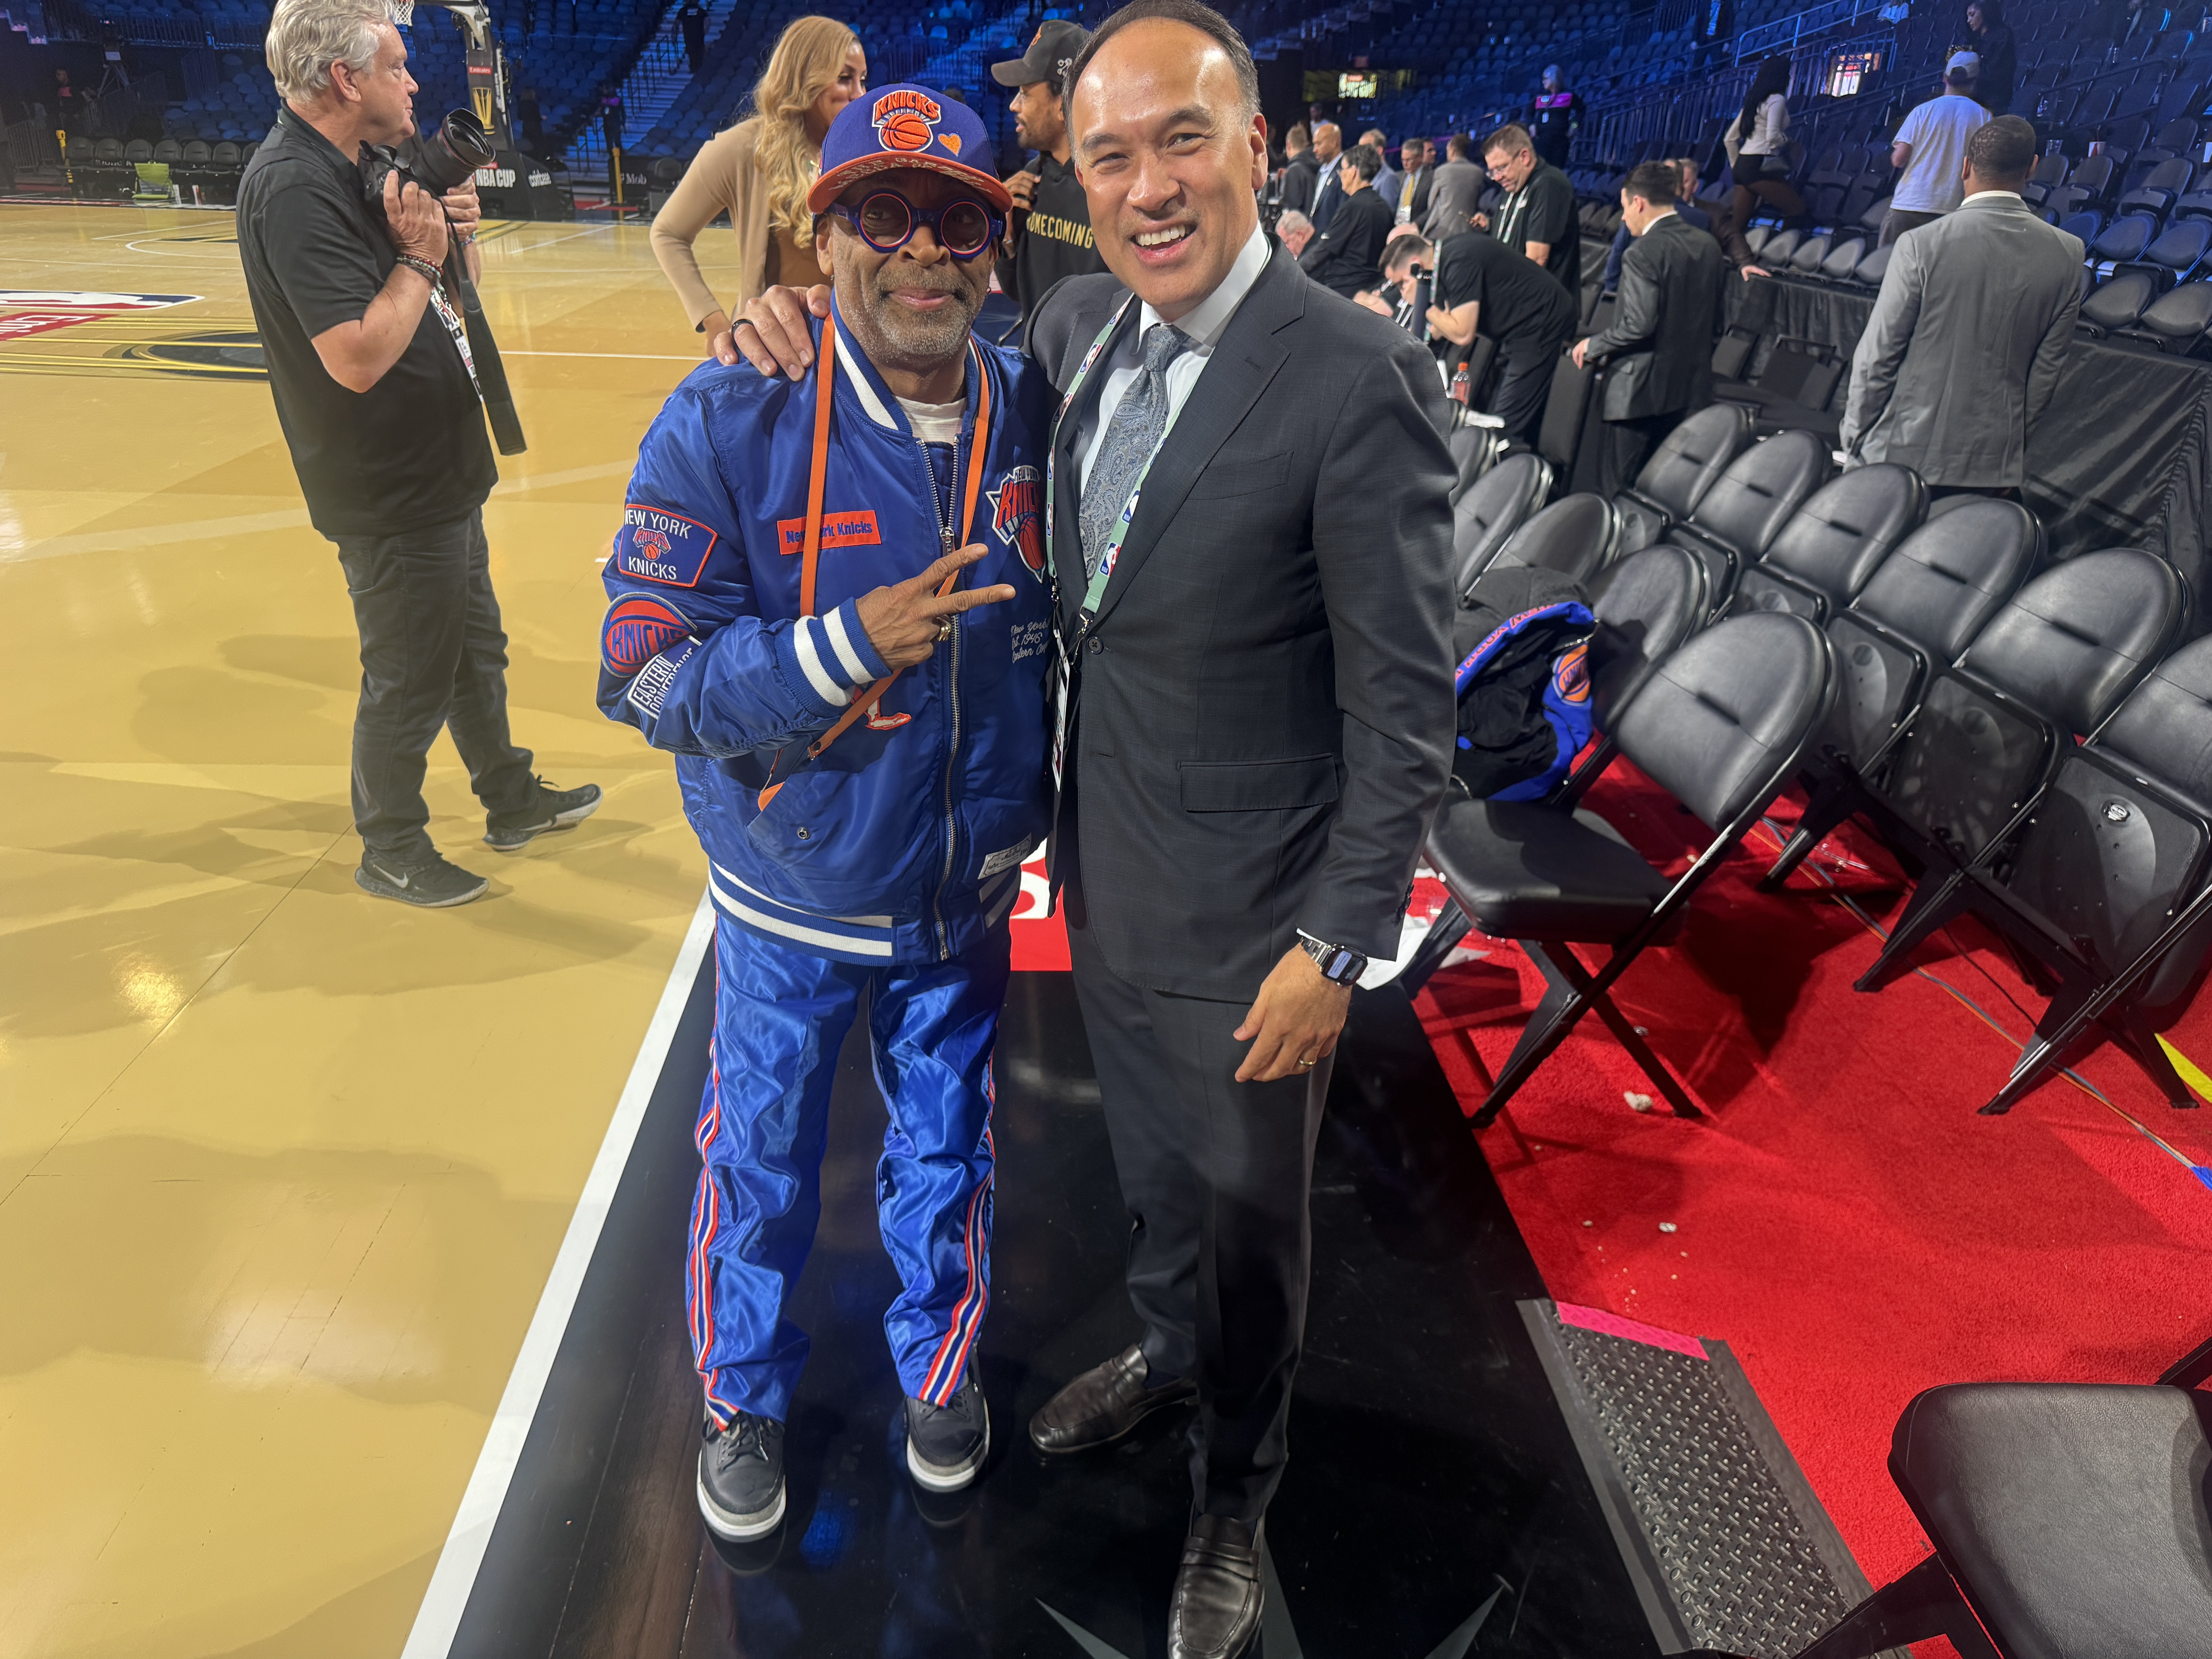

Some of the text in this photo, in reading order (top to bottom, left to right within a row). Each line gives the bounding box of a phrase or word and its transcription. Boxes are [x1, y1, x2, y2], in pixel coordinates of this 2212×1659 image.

[875, 91, 939, 121] KNICKS
[475, 168, 516, 188] NBA CUP
[625, 509, 693, 539] NEW YORK
[819, 524, 836, 538] ork
[837, 520, 873, 536] Knicks
[635, 528, 671, 551] KNICKS
[628, 556, 677, 580] KNICKS
[1010, 624, 1025, 637] New
[1021, 632, 1043, 646] 1946
[1012, 646, 1034, 664] Eastern
[633, 655, 675, 707] EASTERN
